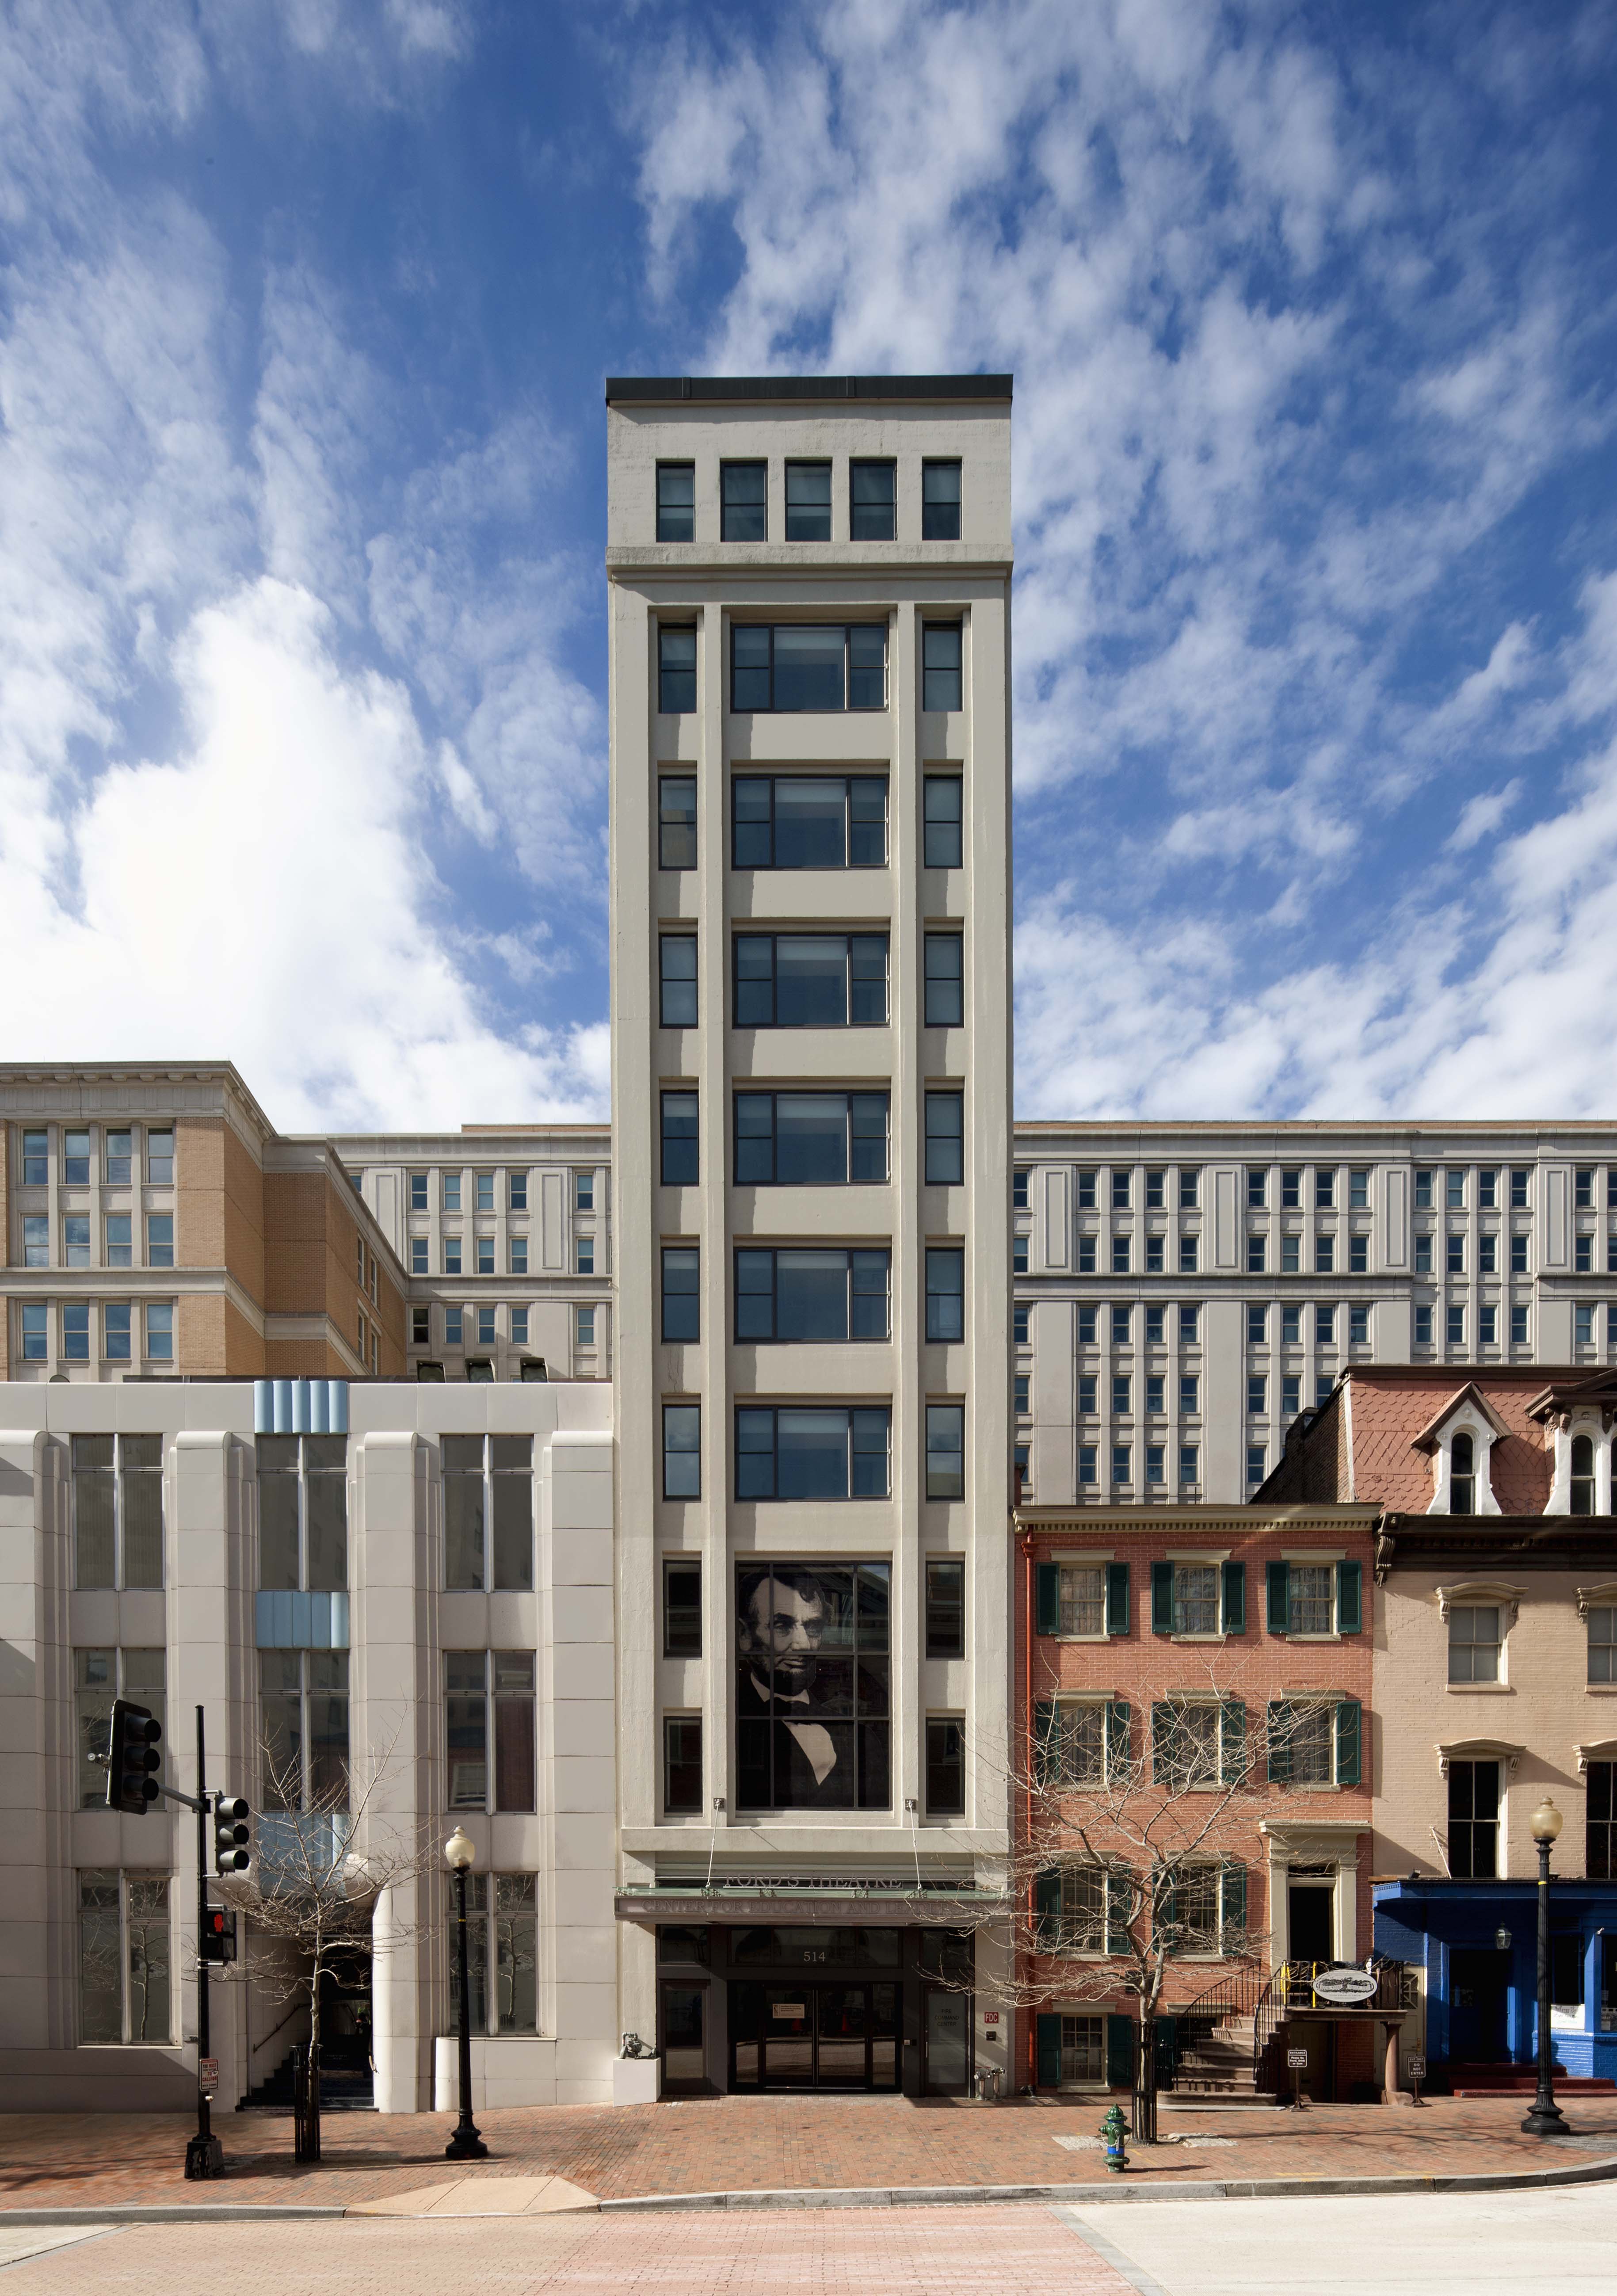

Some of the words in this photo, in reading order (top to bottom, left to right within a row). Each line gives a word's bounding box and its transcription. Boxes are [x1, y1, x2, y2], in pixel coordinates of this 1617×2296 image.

[725, 1873, 799, 1887] FORD'S
[806, 1874, 901, 1888] THEATRE
[642, 1901, 705, 1914] CENTER
[712, 1901, 744, 1914] FOR
[751, 1902, 841, 1914] EDUCATION
[848, 1902, 881, 1914] AND
[804, 1951, 826, 1962] 514
[985, 2013, 998, 2022] FDC
